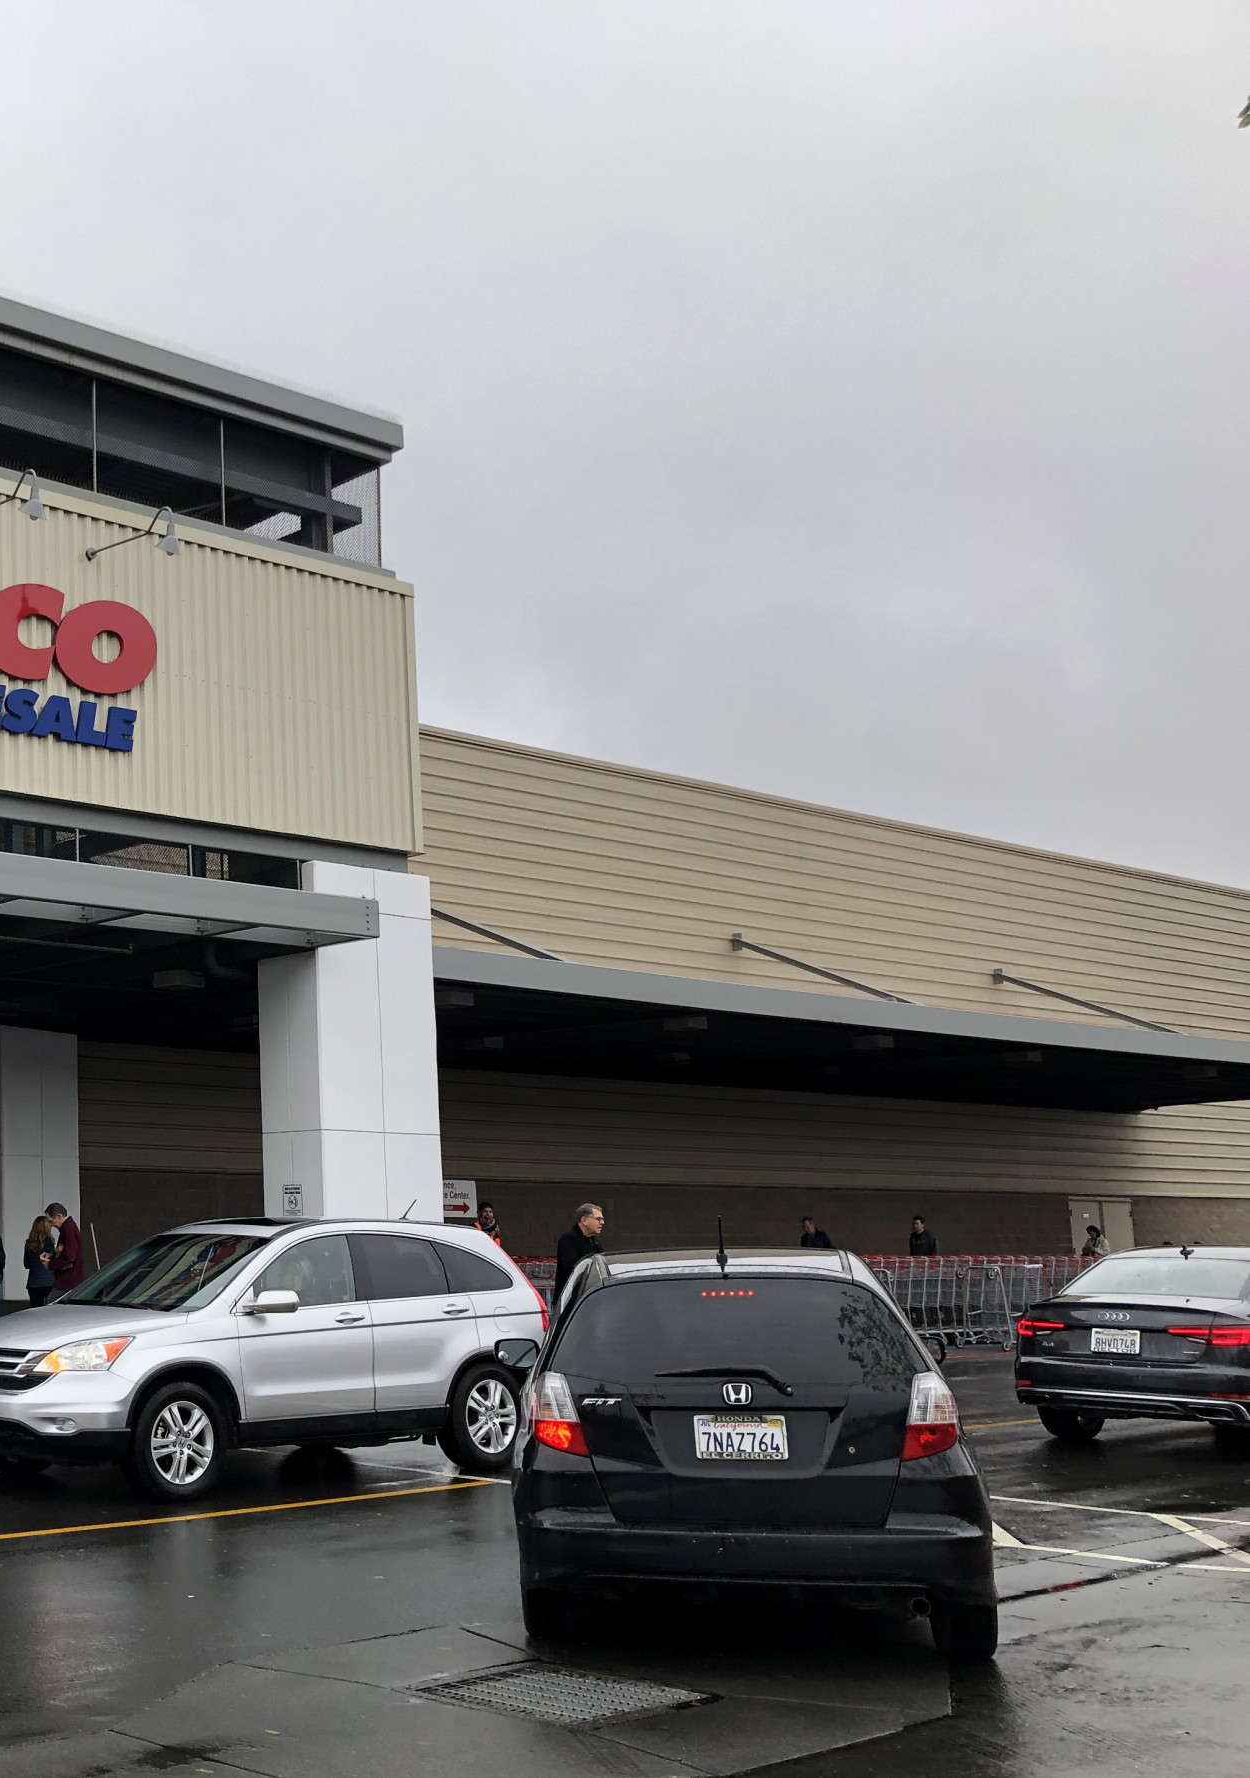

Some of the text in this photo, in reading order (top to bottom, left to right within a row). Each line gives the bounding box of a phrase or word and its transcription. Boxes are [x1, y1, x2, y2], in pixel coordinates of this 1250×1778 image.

[450, 1191, 470, 1199] Center.
[582, 1398, 622, 1406] FIT
[714, 1422, 762, 1431] California
[702, 1432, 780, 1452] 7NAZ764
